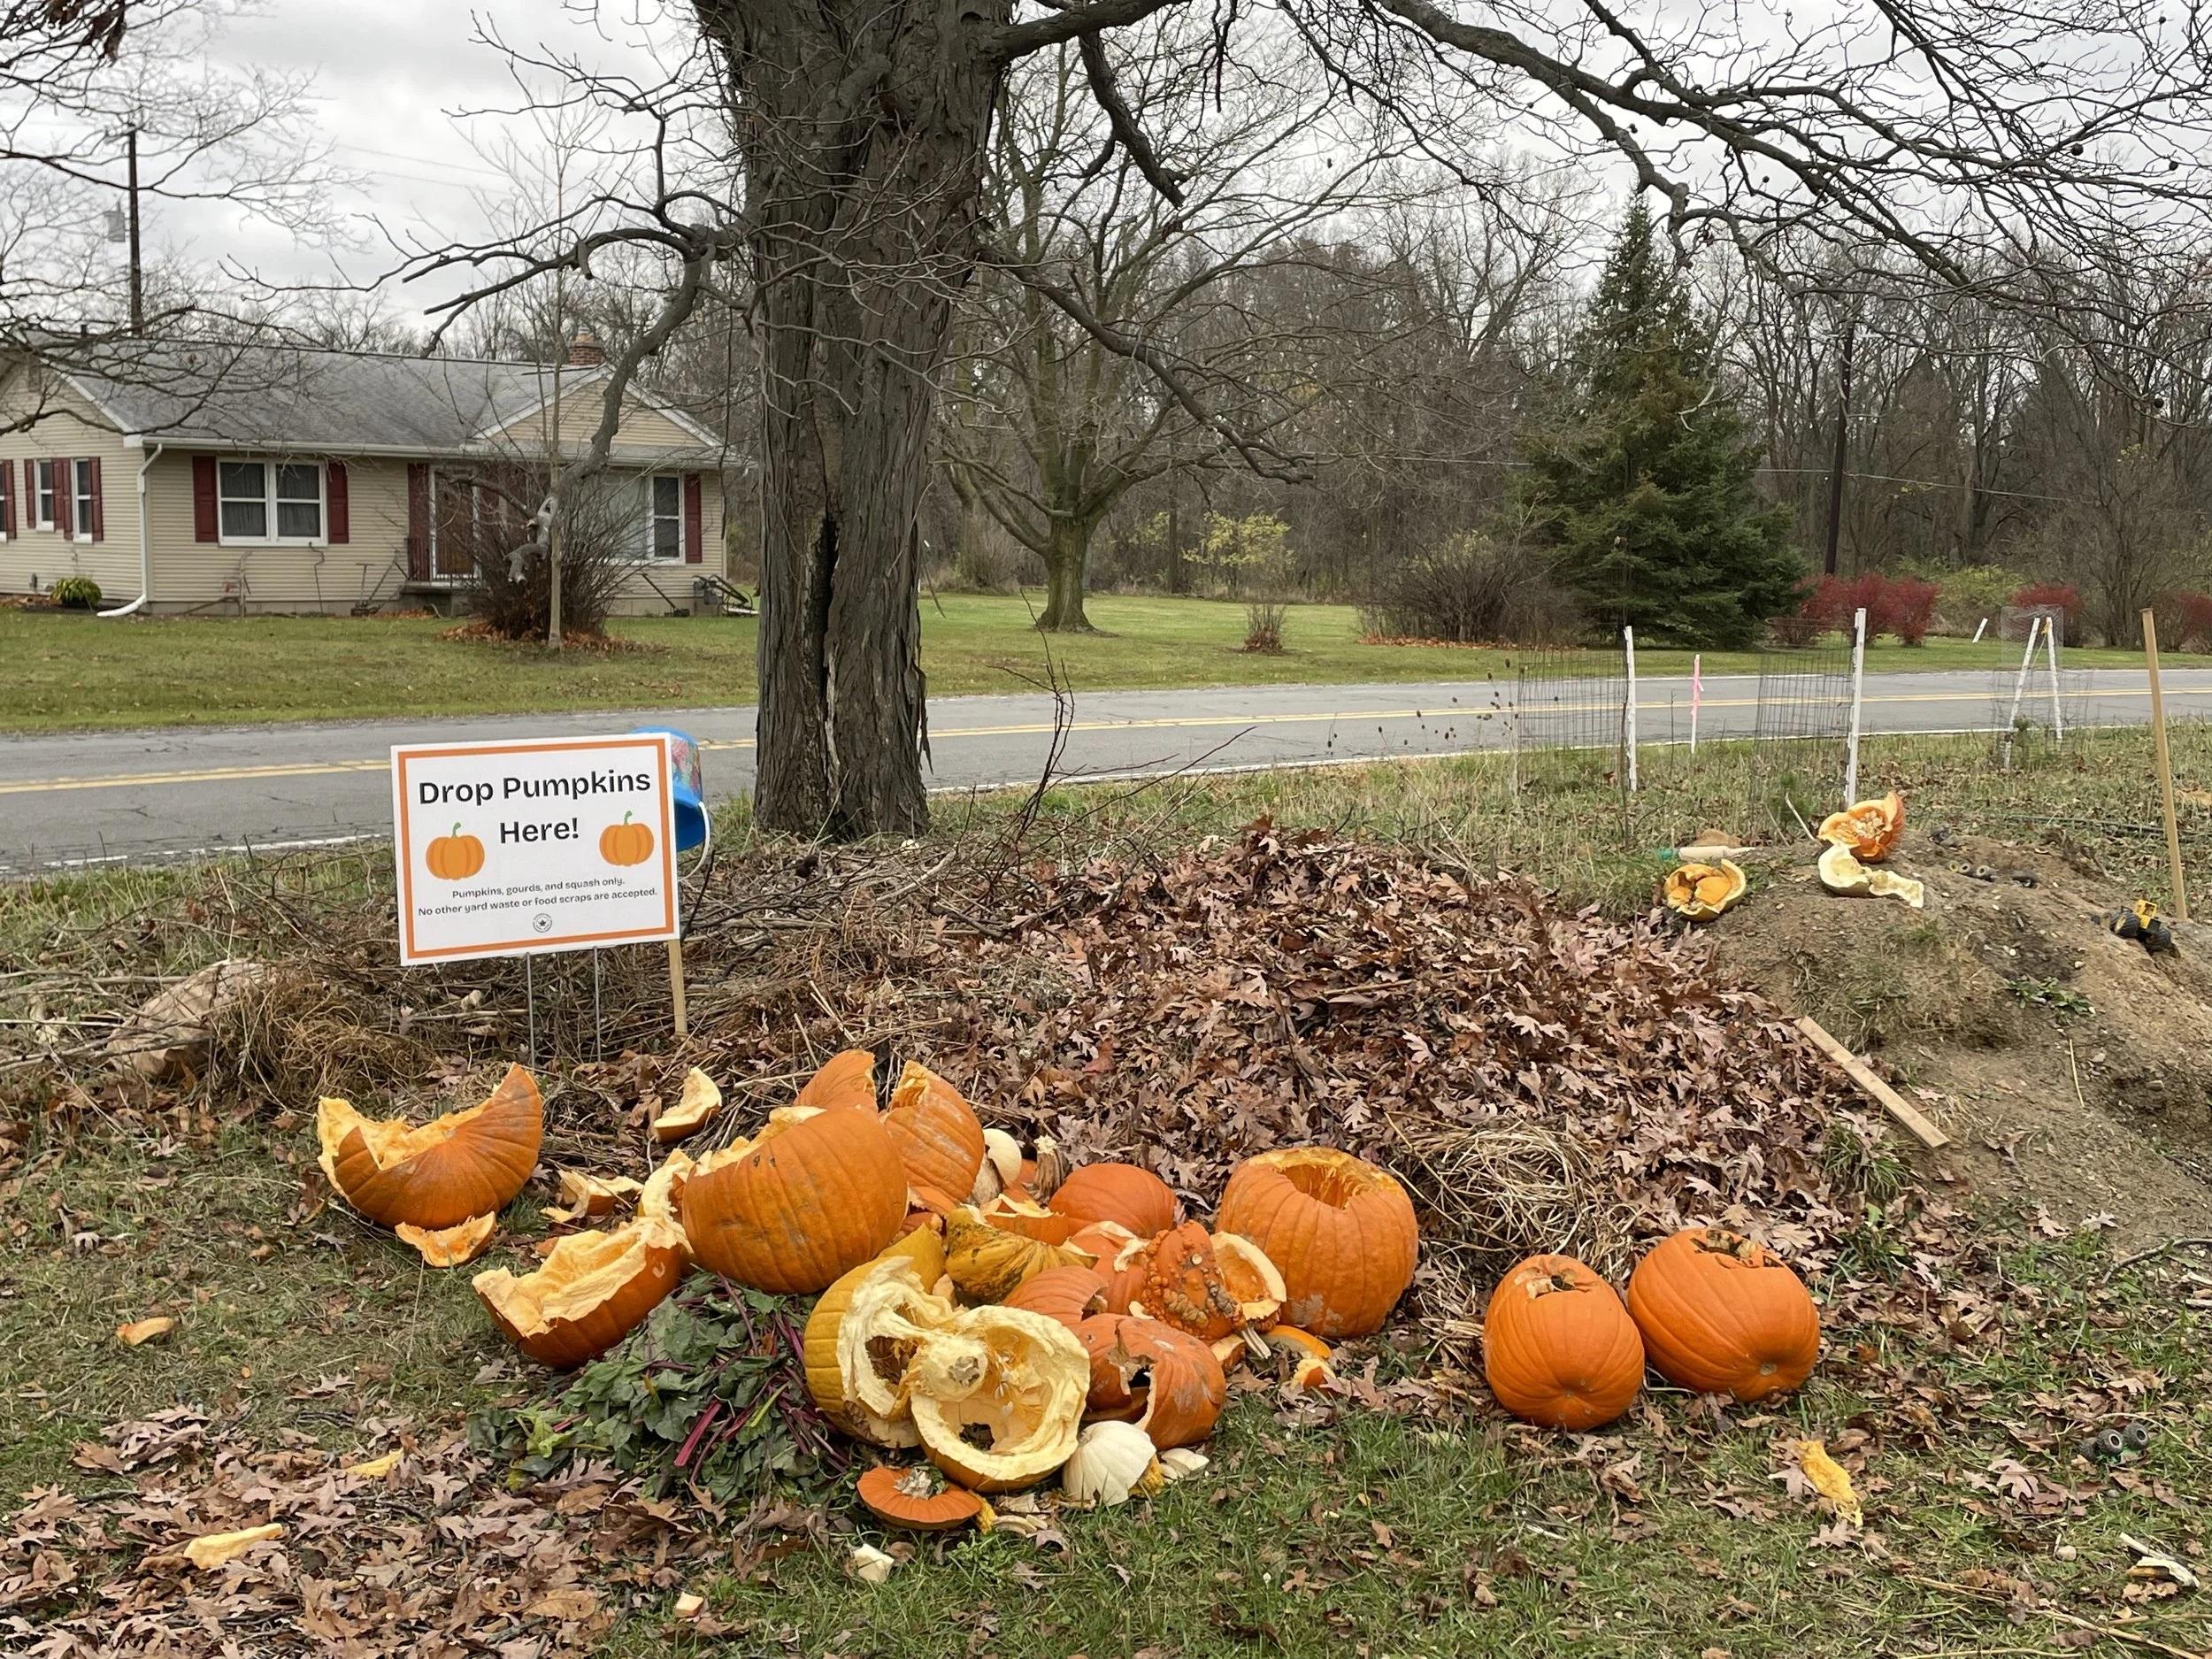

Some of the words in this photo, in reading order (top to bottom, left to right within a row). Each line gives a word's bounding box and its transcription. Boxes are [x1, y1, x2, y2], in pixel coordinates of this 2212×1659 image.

[419, 782, 494, 807] Drop
[503, 769, 651, 801] Pumpkins
[499, 817, 580, 845] Here!
[418, 907, 433, 917] No
[434, 905, 463, 915] other
[465, 902, 488, 914] yard
[489, 900, 520, 910] waste
[534, 896, 557, 906] food
[559, 894, 592, 903] scraps
[594, 892, 610, 901] are
[611, 887, 658, 899] accepted.
[452, 887, 505, 899] Pumpkins,
[506, 884, 543, 896] gourds,
[544, 881, 564, 891] and
[565, 878, 601, 890] squash
[602, 877, 626, 887] only.
